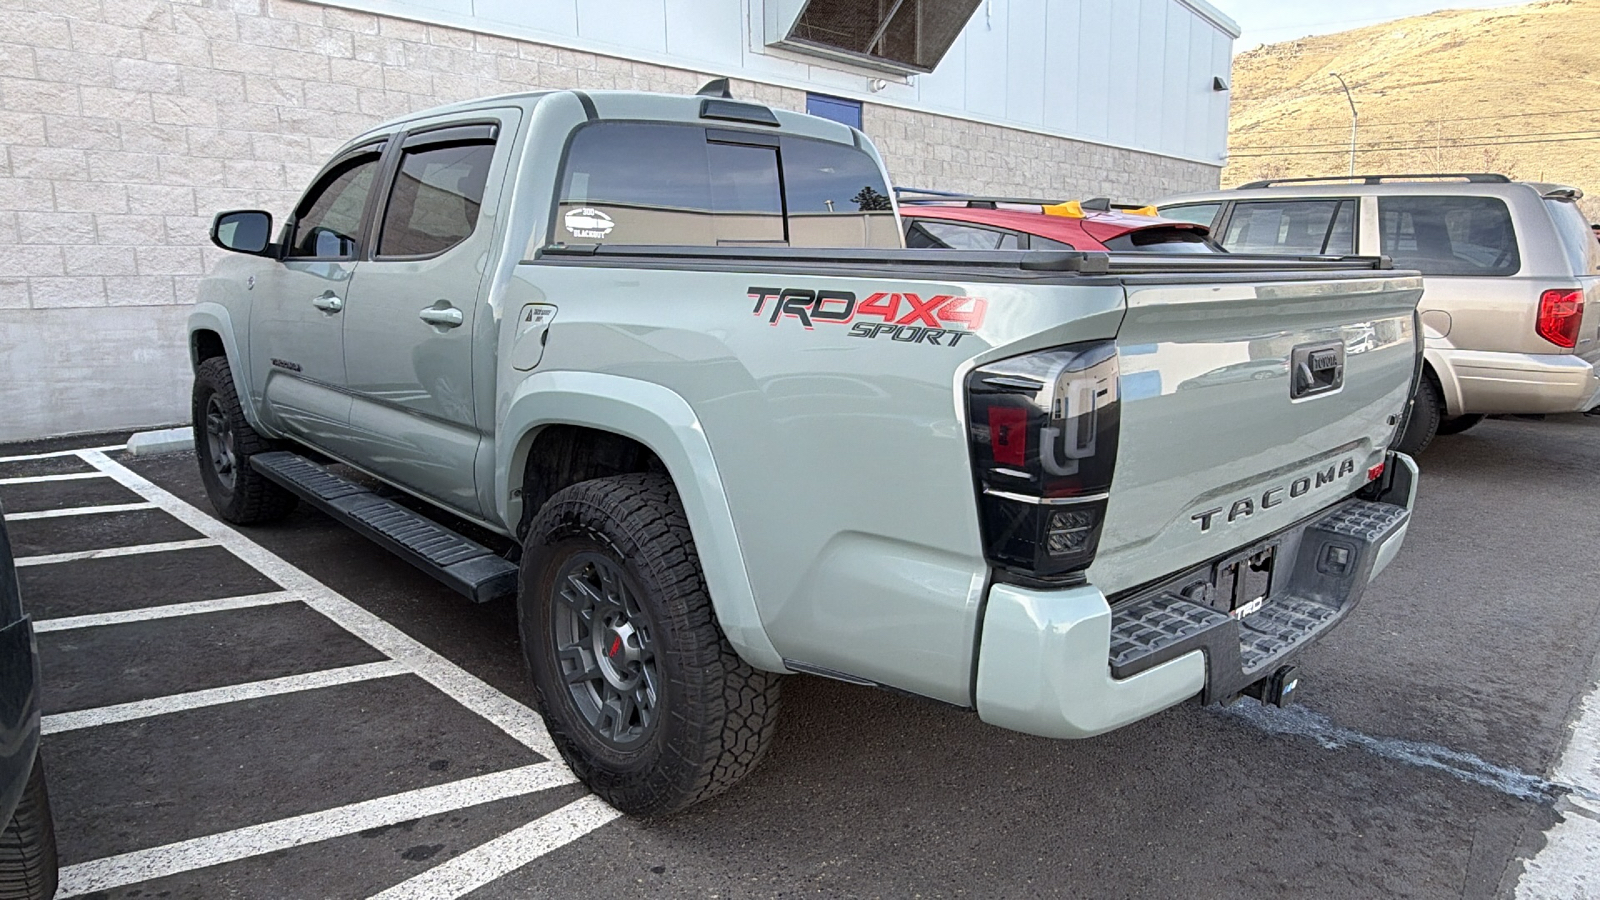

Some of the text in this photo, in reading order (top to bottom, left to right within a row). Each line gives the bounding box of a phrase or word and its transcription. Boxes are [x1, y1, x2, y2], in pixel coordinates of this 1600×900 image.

[847, 321, 974, 347] SPORT
[1191, 457, 1355, 533] TACOMA
[1235, 596, 1263, 620] TRD
